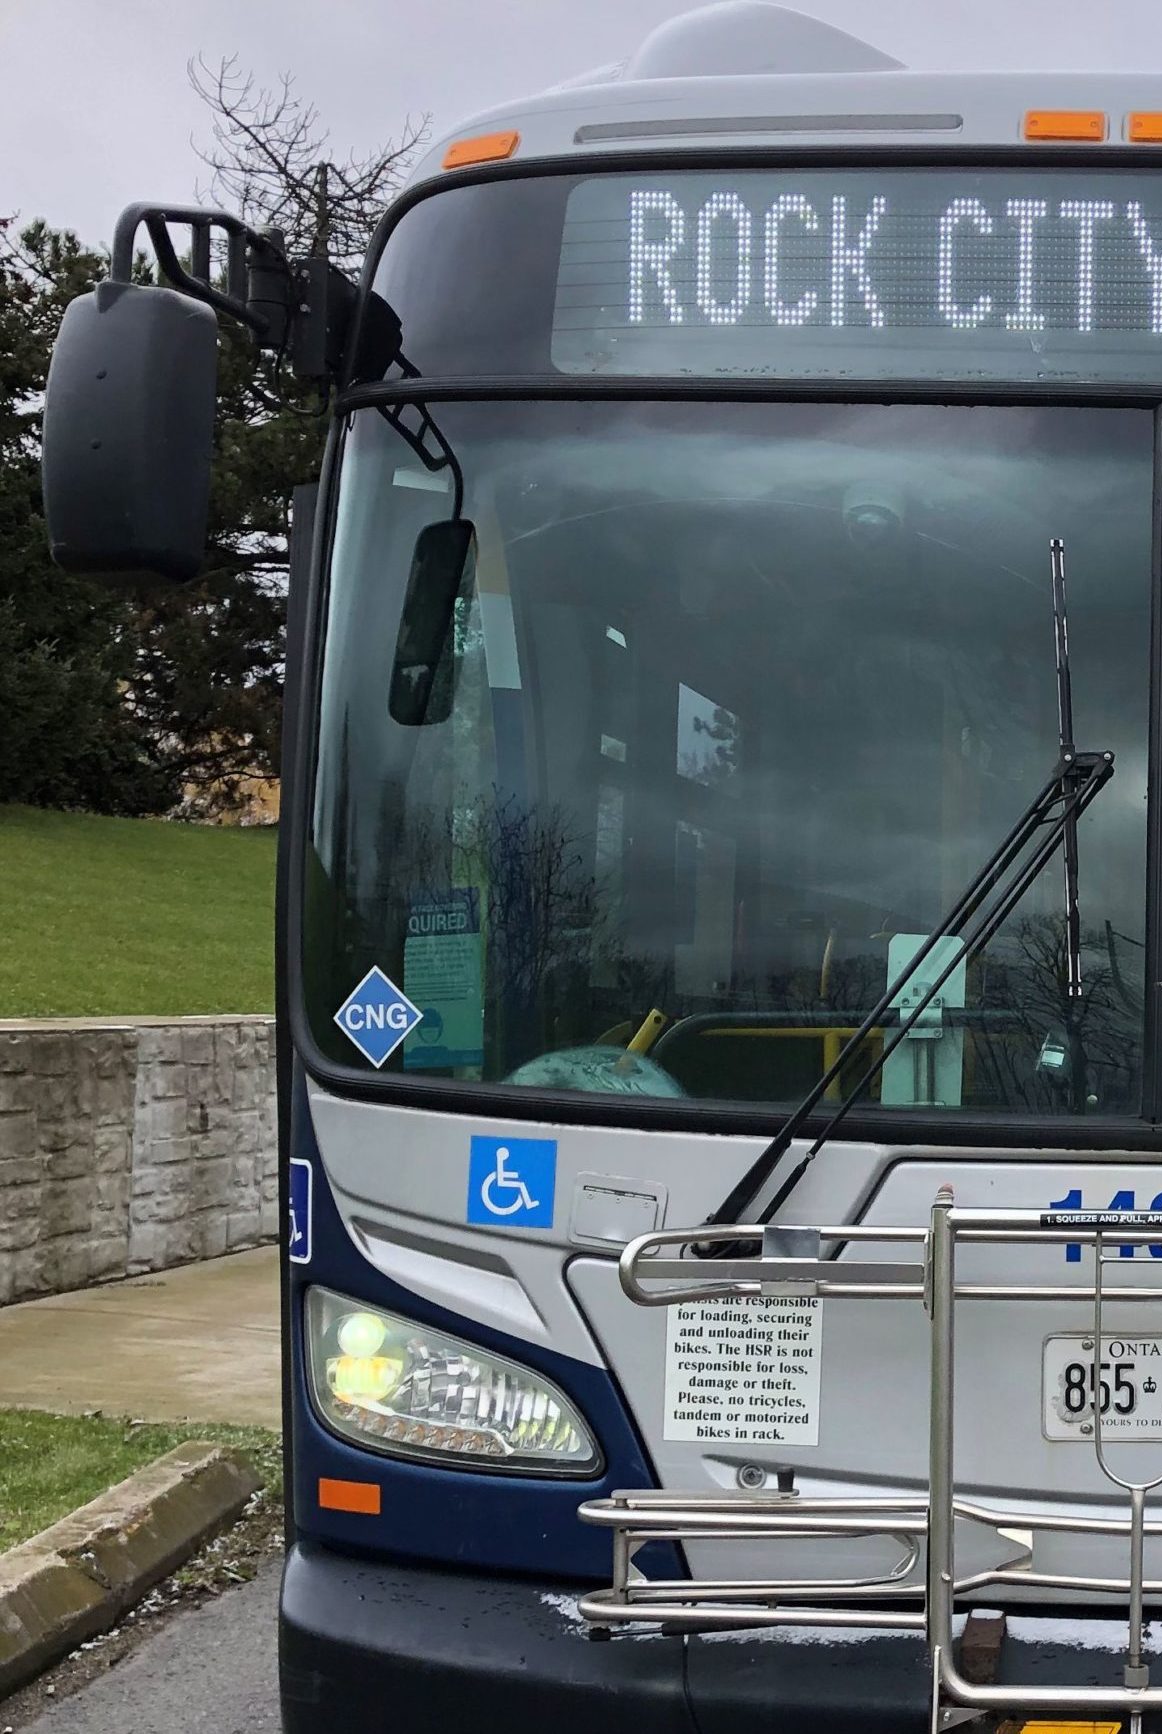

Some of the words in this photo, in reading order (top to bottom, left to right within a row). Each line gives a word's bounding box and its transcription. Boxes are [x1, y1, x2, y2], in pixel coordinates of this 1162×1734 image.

[629, 190, 886, 328] ROCK
[345, 1003, 408, 1031] CNG
[1056, 1215, 1098, 1223] SQUEEZE
[1099, 1215, 1118, 1223] AND
[722, 1298, 742, 1306] are
[746, 1298, 818, 1309] responsible
[678, 1309, 696, 1321] for
[701, 1310, 752, 1325] loading,
[757, 1313, 812, 1327] securing
[680, 1327, 703, 1337] and
[709, 1328, 773, 1343] unloading
[779, 1330, 809, 1341] their
[675, 1343, 711, 1355] bikes.
[717, 1343, 740, 1355] The
[746, 1345, 772, 1357] HSR
[777, 1346, 787, 1357] is
[792, 1347, 813, 1358] not
[679, 1361, 751, 1373] responsible
[757, 1361, 775, 1373] for
[780, 1363, 807, 1375] loss,
[689, 1376, 738, 1391] damage
[744, 1381, 757, 1389] or
[762, 1379, 795, 1391] theft.
[1065, 1363, 1135, 1413] 855
[679, 1392, 723, 1405] Please,
[729, 1397, 744, 1405] no
[750, 1395, 805, 1409] tricycles,
[674, 1410, 721, 1421] tandem
[727, 1414, 740, 1422] or
[745, 1413, 808, 1424] motorized
[1136, 1419, 1148, 1427] TO
[697, 1426, 730, 1438] bikes
[736, 1428, 747, 1439] in
[753, 1429, 784, 1440] rack.
